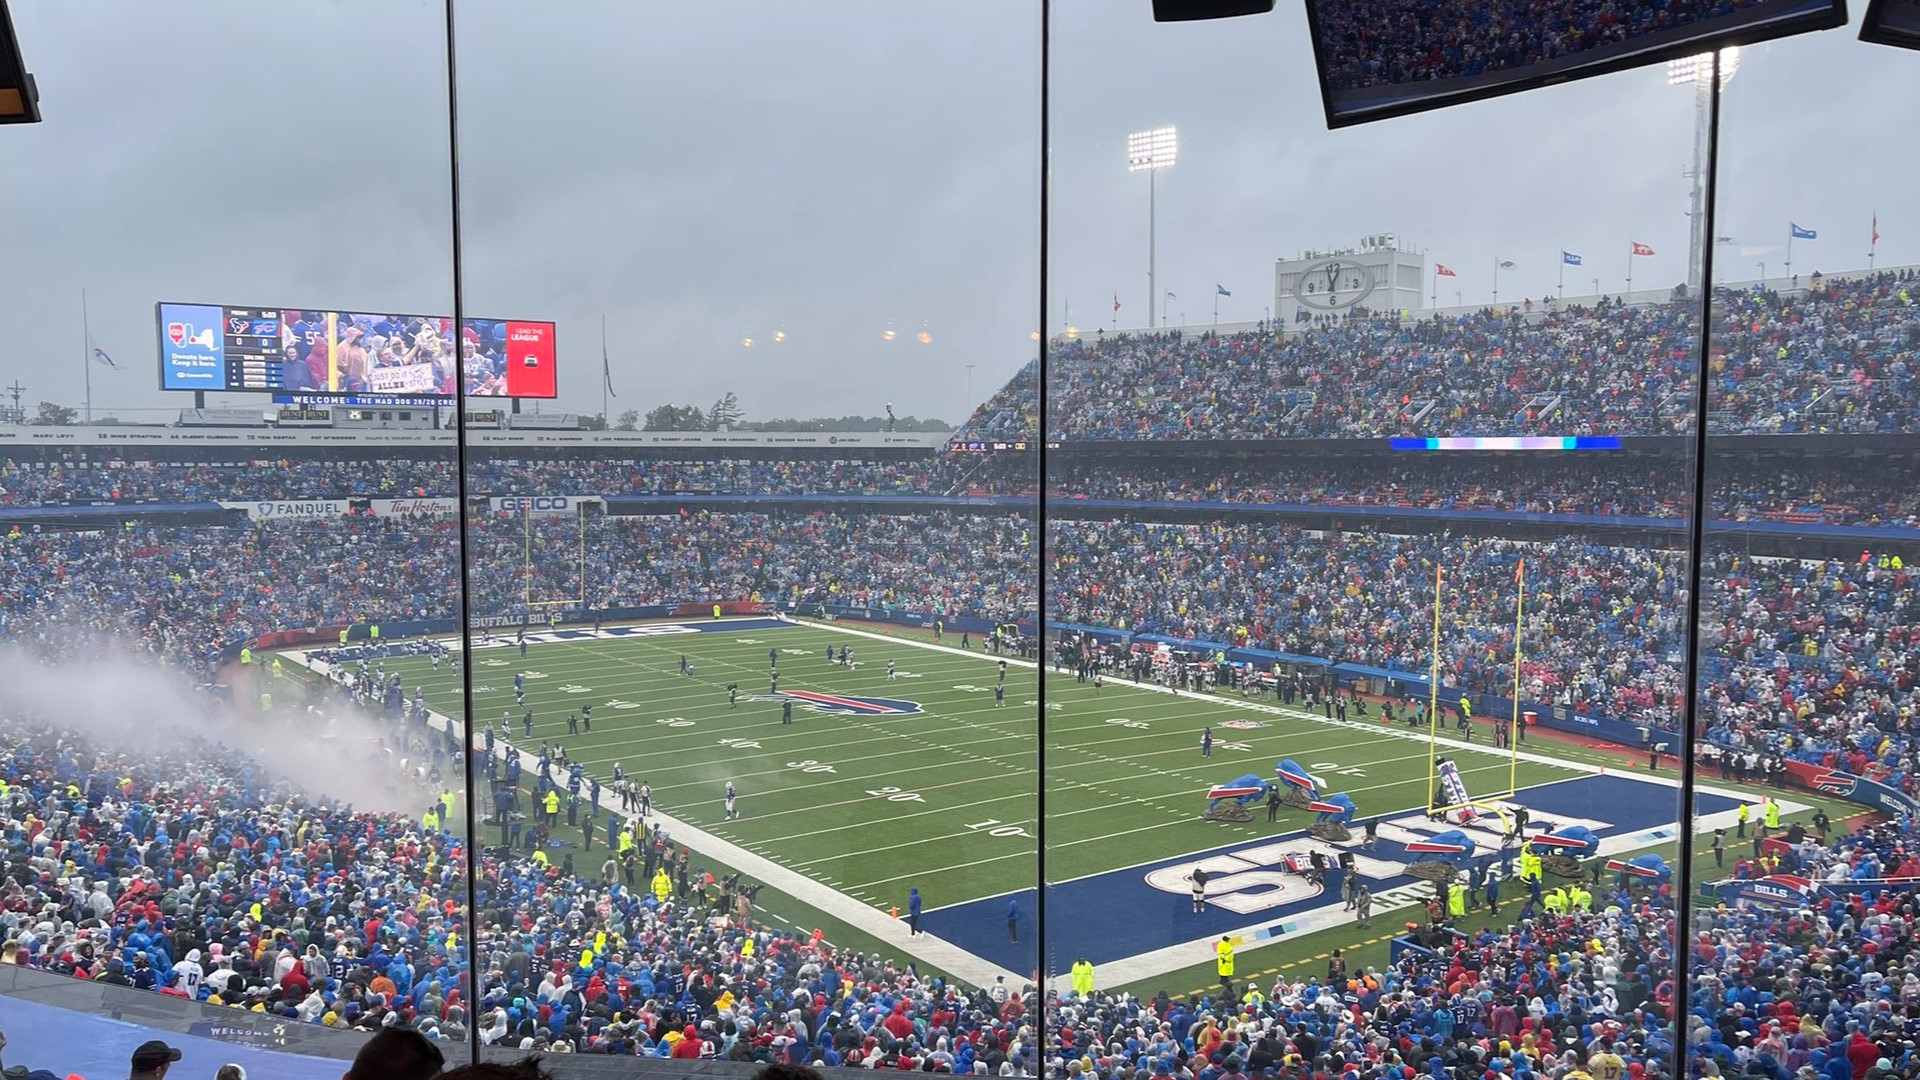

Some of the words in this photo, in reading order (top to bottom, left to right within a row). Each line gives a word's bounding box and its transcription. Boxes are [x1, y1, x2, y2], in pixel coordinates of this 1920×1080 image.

[1329, 264, 1340, 273] 12
[1308, 283, 1314, 292] 9
[1353, 279, 1359, 289] 3
[1330, 296, 1336, 305] 6
[236, 337, 242, 345] 0
[292, 395, 350, 404] WELCOME:
[277, 503, 341, 514] FANDUEL
[390, 500, 410, 513] Tim
[500, 497, 568, 510] GEICO
[470, 615, 523, 628] BUFFALO
[786, 759, 833, 773] 30
[865, 786, 920, 802] 20
[964, 818, 1025, 837] 10
[1754, 884, 1788, 898] BILLS
[188, 973, 198, 986] 17
[675, 983, 683, 993] 17
[687, 1013, 697, 1022] 17
[1467, 1008, 1476, 1017] 17
[1457, 1014, 1464, 1024] 17
[1604, 1066, 1617, 1079] 17
